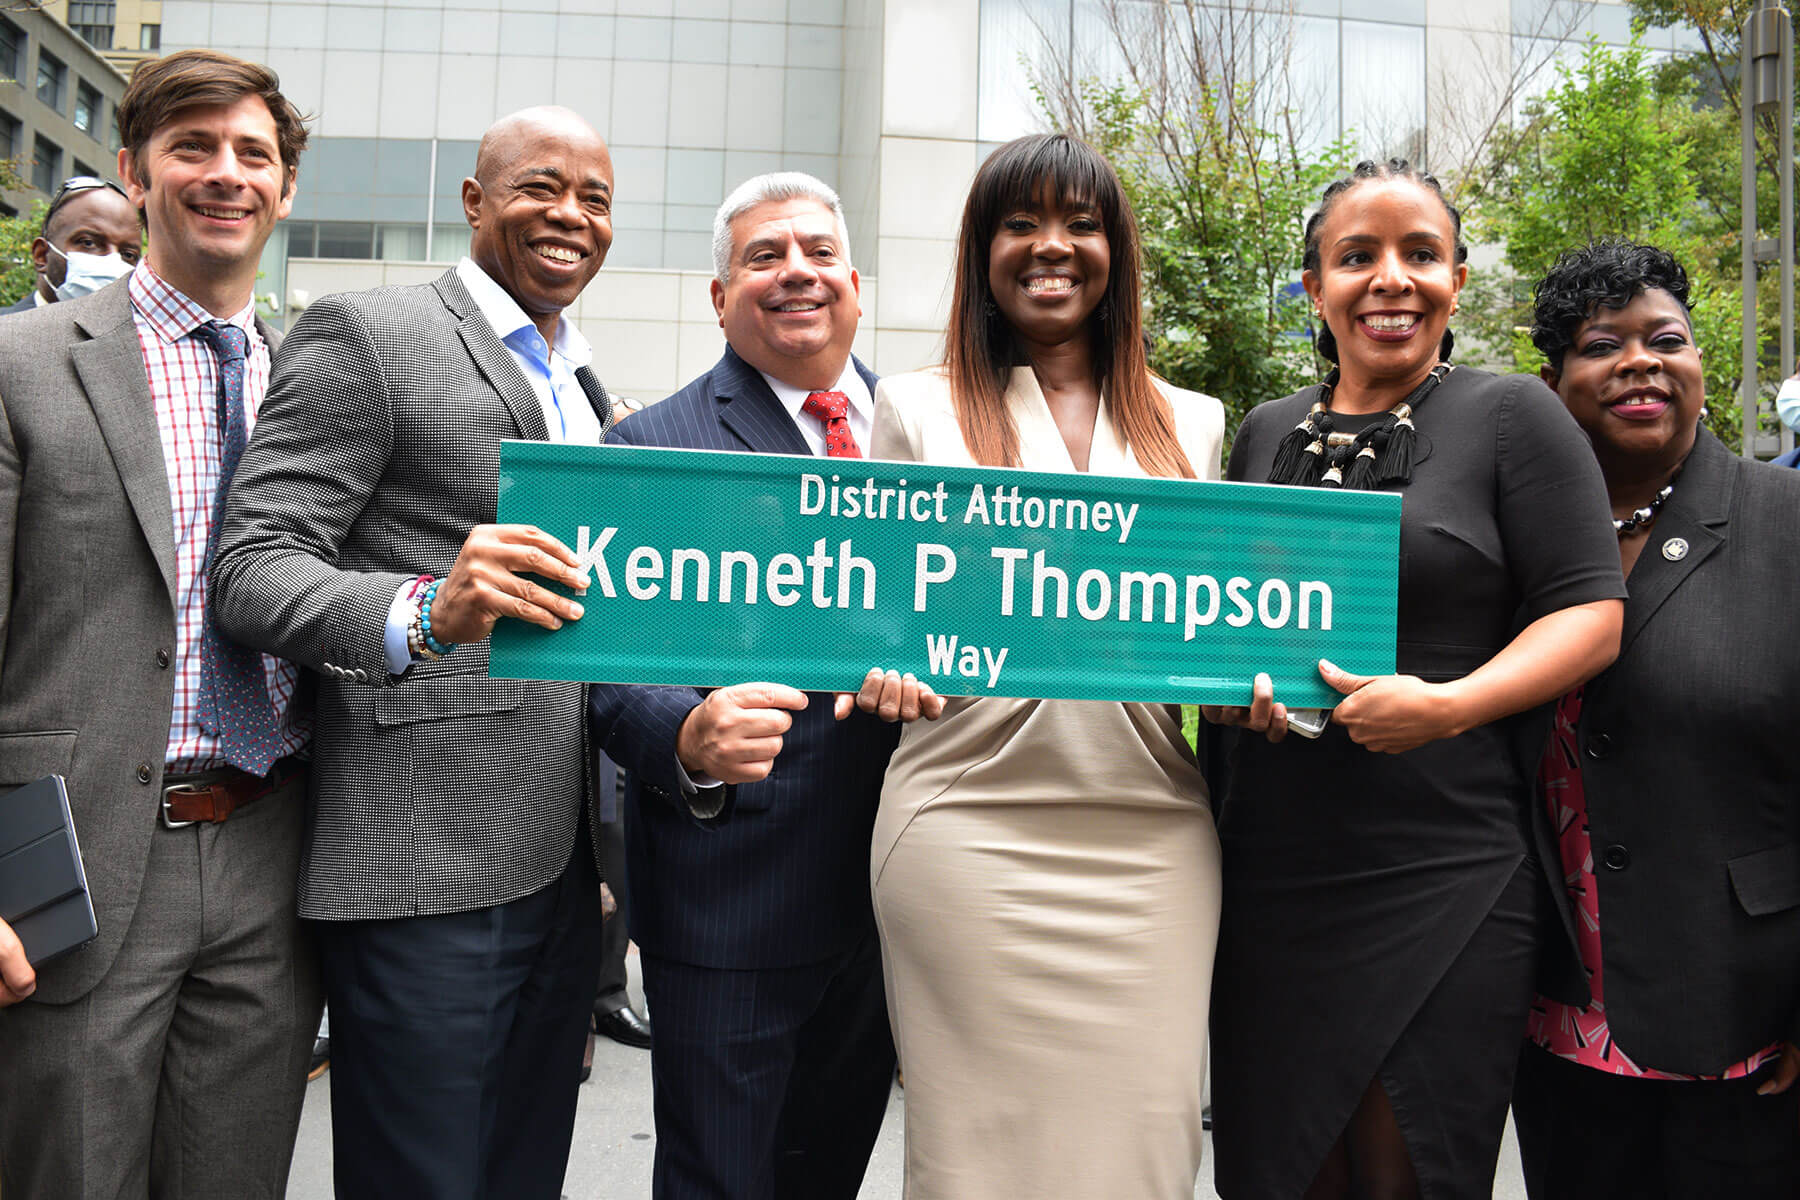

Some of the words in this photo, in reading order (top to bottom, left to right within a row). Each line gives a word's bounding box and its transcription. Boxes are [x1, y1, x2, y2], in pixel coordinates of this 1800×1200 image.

[799, 473, 949, 523] District
[963, 483, 1140, 544] Attorney
[575, 525, 877, 610] Kenneth
[914, 542, 957, 612] P
[990, 546, 1333, 642] Thompson
[926, 633, 1009, 689] Way
